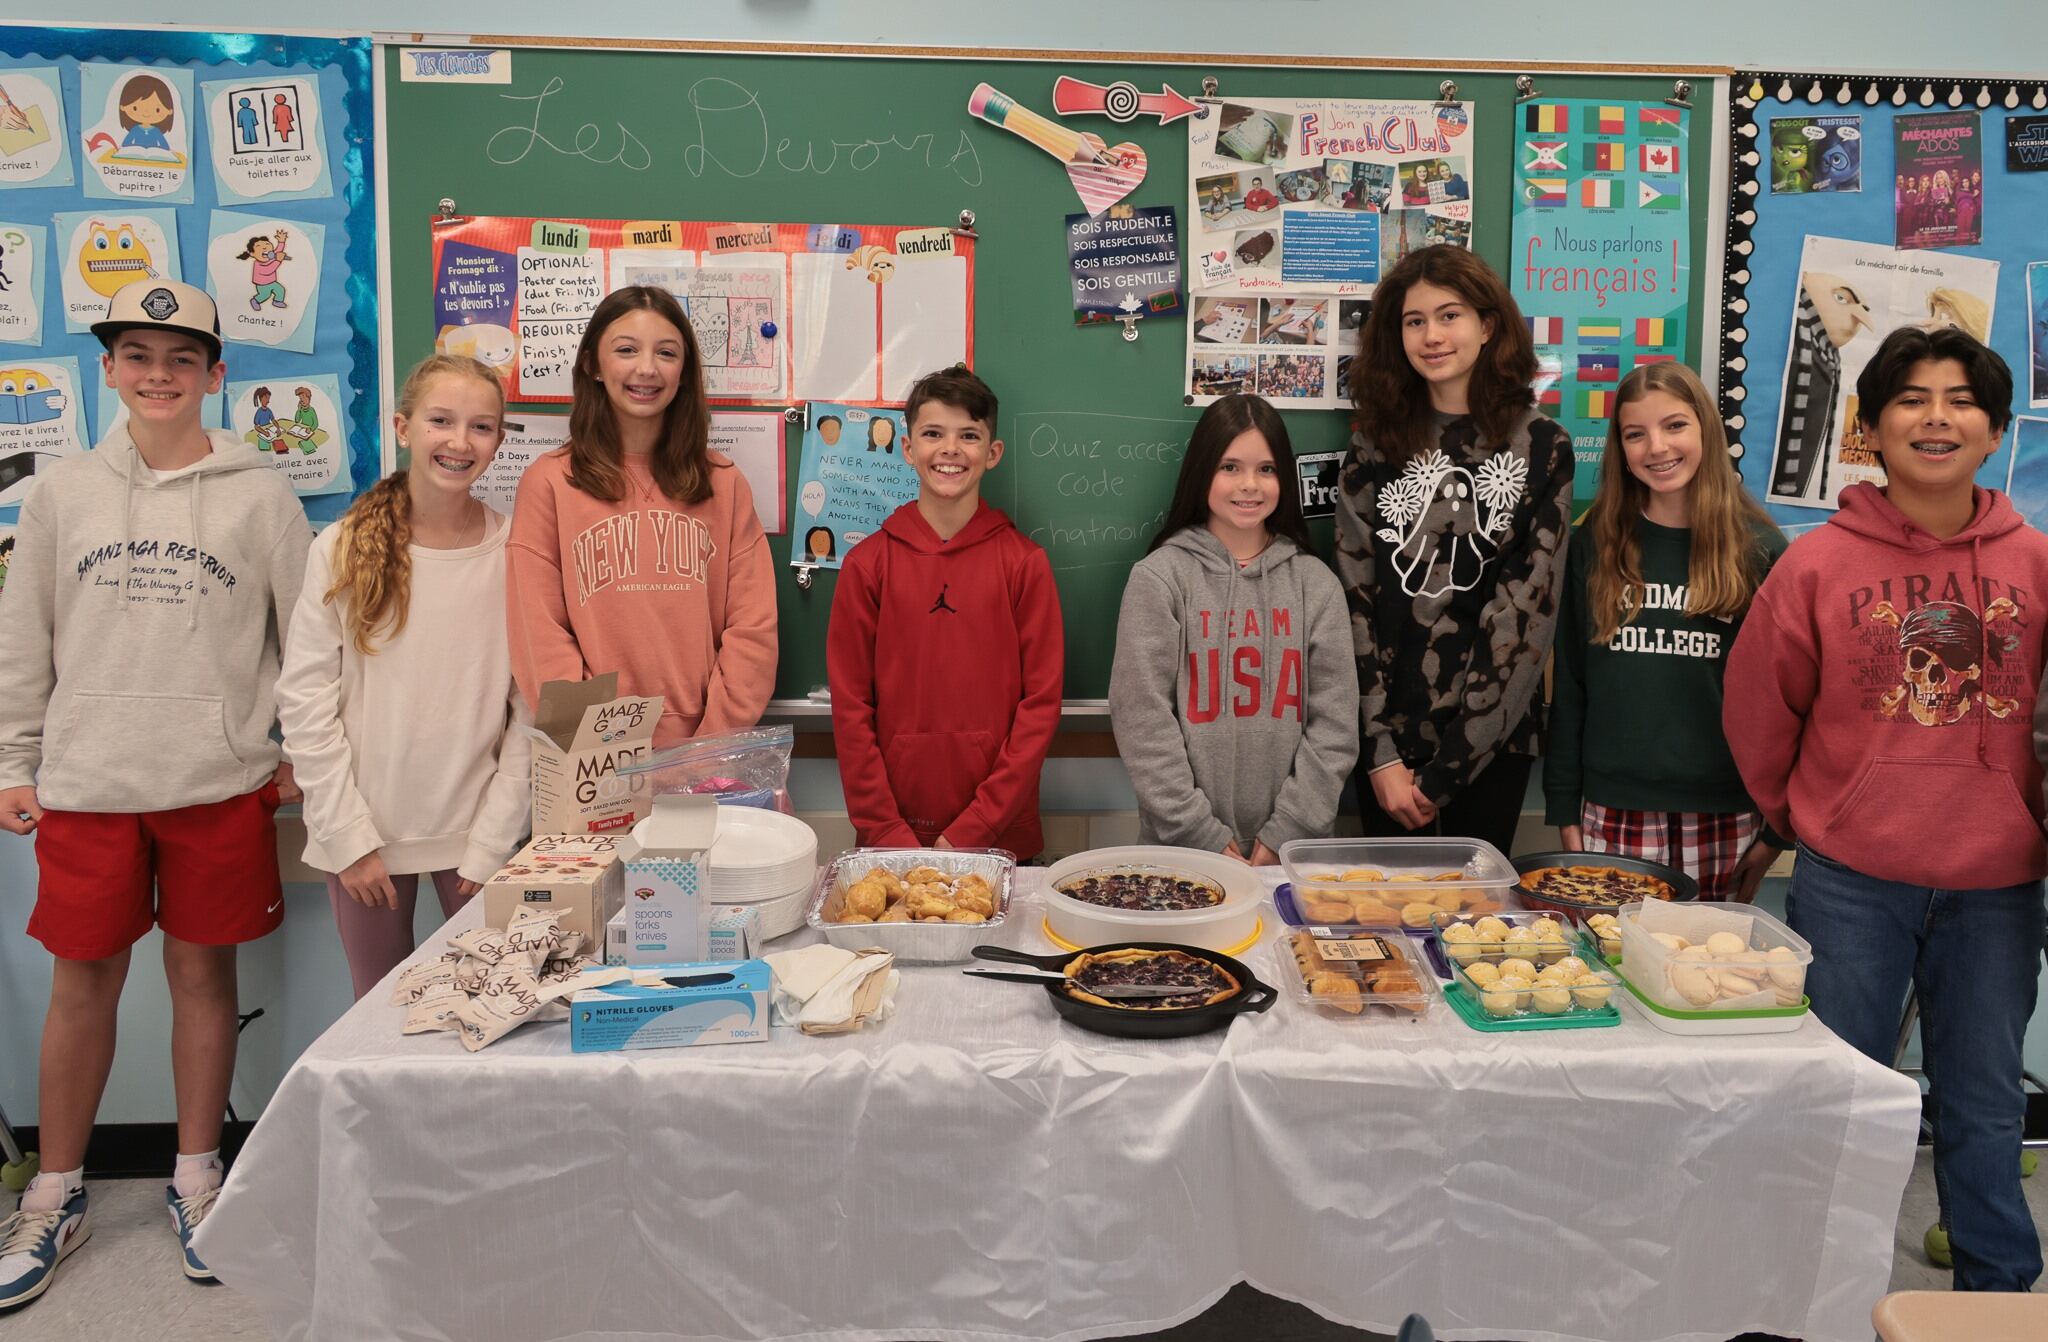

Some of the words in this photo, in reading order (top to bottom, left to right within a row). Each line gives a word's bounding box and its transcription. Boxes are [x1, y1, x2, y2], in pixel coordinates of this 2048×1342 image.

[415, 53, 436, 75] les
[1328, 111, 1355, 131] Join
[487, 77, 650, 170] Les
[685, 77, 982, 187] Devoirs
[1902, 127, 1973, 142] MÉCHANTES
[1917, 138, 1960, 153] ADOS
[0, 160, 31, 170] crivez
[229, 156, 264, 168] Puis-je
[267, 154, 293, 165] aller
[296, 154, 312, 163] aux
[102, 166, 165, 180] Débarrassez
[168, 170, 178, 181] le
[247, 168, 288, 179] toilettes
[119, 181, 155, 194] pupitre
[1071, 221, 1102, 236] SOIS
[1105, 215, 1172, 233] PRUDENT.E
[541, 225, 579, 249] lundi
[633, 224, 673, 245] mardi
[715, 224, 773, 250] mercredi
[1073, 240, 1097, 251] SOIS
[1100, 233, 1174, 249] RESPECTUEUX.E
[1554, 226, 1597, 252] Nous
[1602, 225, 1663, 259] parlons
[899, 232, 952, 254] vendredi
[456, 255, 495, 266] Monsieur
[521, 256, 594, 271] OPTIONAL:
[1074, 258, 1100, 270] SOIS
[1102, 251, 1176, 267] RESPONSABLE
[1855, 258, 1866, 268] Un
[1898, 263, 1909, 273] air
[1910, 264, 1920, 273] de
[1921, 265, 1945, 278] famille
[447, 266, 485, 276] Fromage
[486, 265, 499, 273] dit
[1524, 235, 1657, 307] français
[449, 280, 487, 295] N'oublie
[489, 282, 506, 296] pas
[560, 276, 597, 286] contest
[1077, 276, 1111, 292] SOIS
[1114, 270, 1176, 288] GENTIL.E
[524, 289, 550, 300] (due
[555, 288, 574, 297] Fri.
[70, 304, 107, 312] Silence,
[444, 298, 459, 311] tes
[461, 296, 494, 310] devoirs
[237, 315, 276, 328] Chantez
[523, 344, 566, 359] Finish
[522, 364, 551, 379] c'est
[25, 427, 34, 436] le
[37, 426, 58, 435] livre
[35, 439, 64, 447] cahier
[528, 437, 565, 445] Availability
[1029, 423, 1102, 459] Quiz
[1574, 436, 1595, 448] OVER
[274, 459, 302, 470] aillez
[306, 457, 328, 466] avec
[498, 451, 505, 460] B
[508, 452, 530, 462] Days
[819, 455, 863, 469] NEVER
[871, 462, 902, 472] MAKE
[1573, 451, 1597, 463] SPEAK
[822, 469, 871, 483] SOMEONE
[876, 476, 900, 485] WHO
[1057, 468, 1125, 497] code
[831, 485, 858, 496] WITH
[862, 488, 876, 497] AN
[880, 488, 915, 499] ACCENT
[830, 498, 860, 509] MEANS
[865, 502, 888, 513] THEY
[827, 511, 870, 525] ANOTHER
[571, 510, 640, 608] NEW
[130, 567, 157, 575] SINCE
[615, 583, 662, 592] AMERICAN
[663, 583, 691, 592] EAGLE
[1199, 607, 1292, 639] TEAM
[1609, 625, 1721, 659] COLLEGE
[1186, 645, 1304, 725] USA
[596, 701, 649, 721] MADE
[575, 746, 646, 782] MADE
[593, 803, 609, 811] BAKED
[537, 836, 625, 844] MADE
[634, 910, 673, 923] spoons
[635, 919, 660, 930] forks
[635, 931, 668, 941] knives
[711, 946, 736, 954] spoon
[502, 975, 542, 1010] MADE
[596, 1006, 635, 1016] NITRILE
[636, 1004, 674, 1014] GLOVES
[596, 1015, 639, 1025] Non-Medical
[730, 1029, 760, 1039] 100pcs
